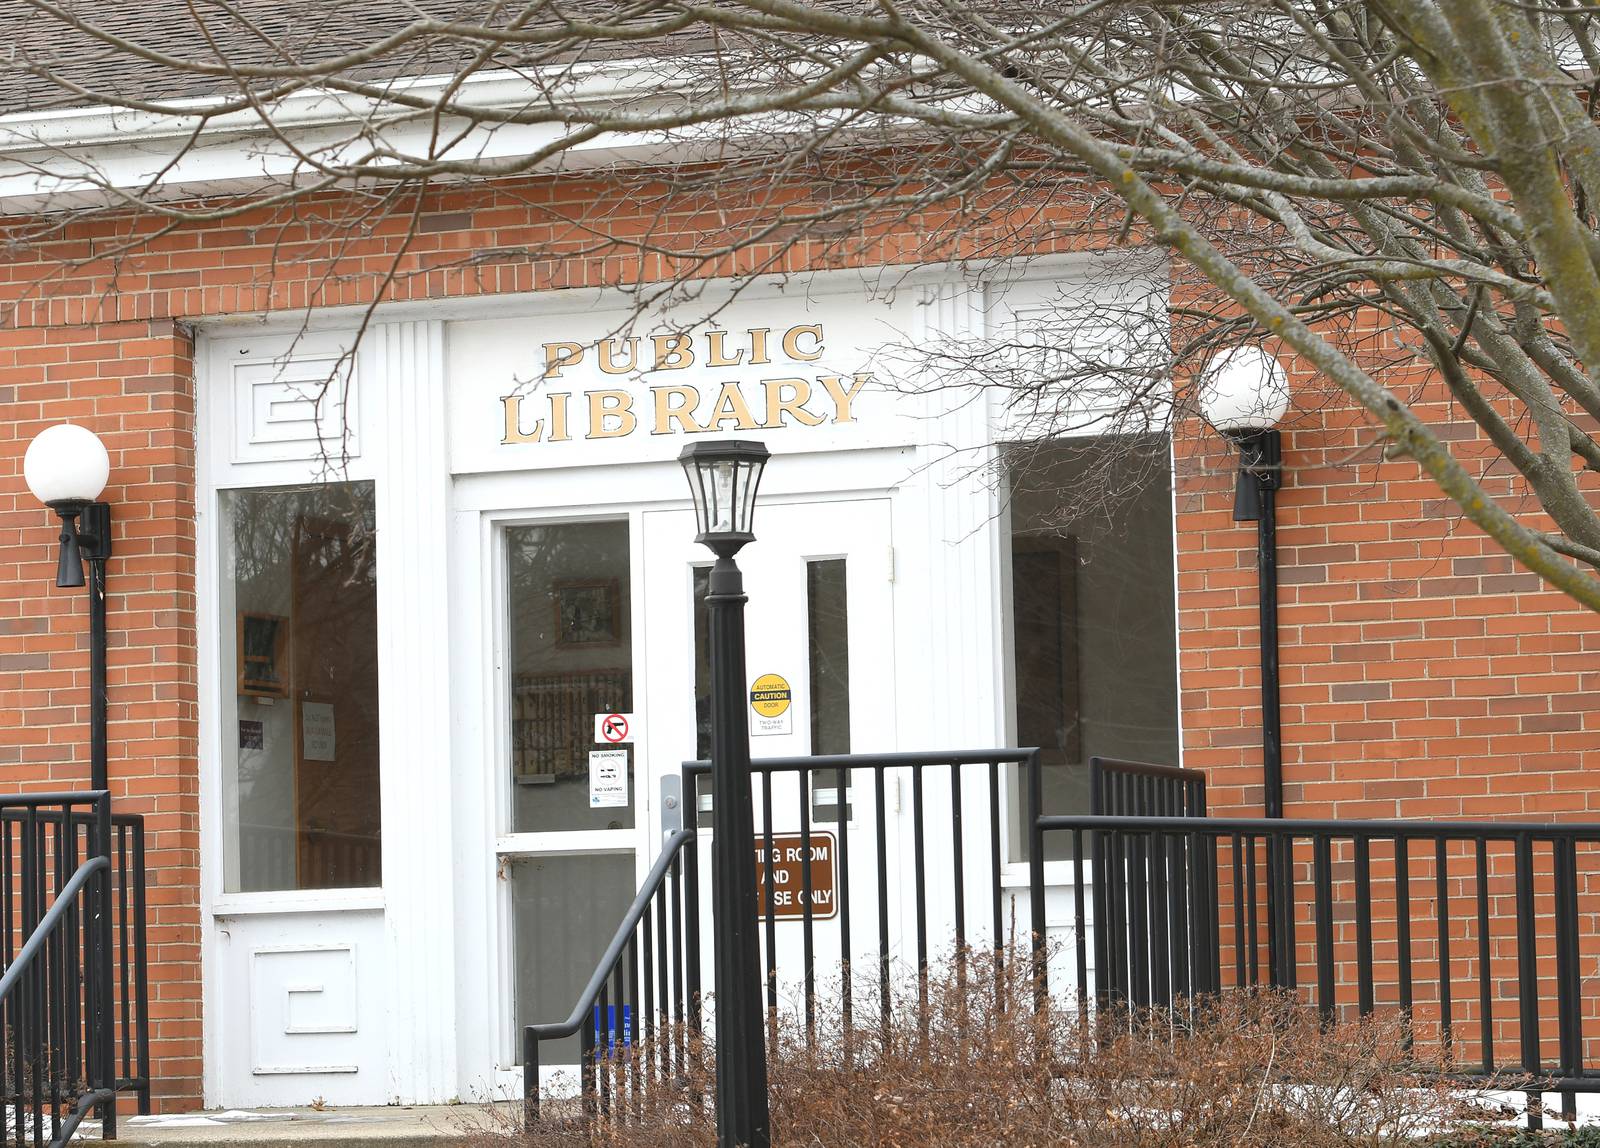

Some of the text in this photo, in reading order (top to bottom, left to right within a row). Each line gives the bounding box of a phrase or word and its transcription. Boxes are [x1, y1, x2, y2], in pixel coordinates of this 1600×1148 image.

[541, 323, 824, 379] PUBLIC
[499, 372, 874, 445] LIBRARY
[754, 692, 788, 700] CAUTION
[786, 846, 828, 862] ROOM
[773, 891, 792, 906] SE
[797, 889, 832, 904] ONLY
